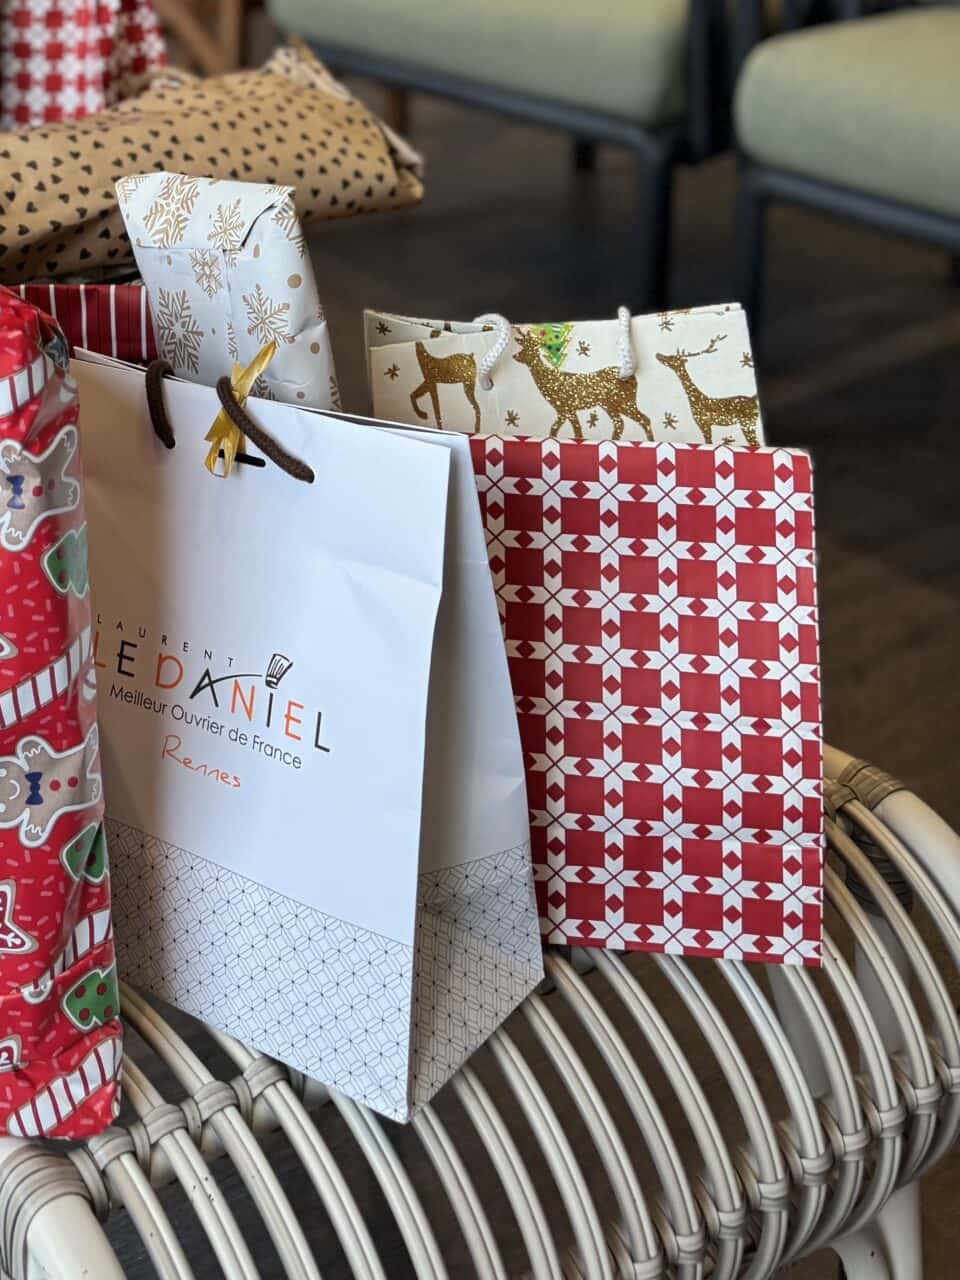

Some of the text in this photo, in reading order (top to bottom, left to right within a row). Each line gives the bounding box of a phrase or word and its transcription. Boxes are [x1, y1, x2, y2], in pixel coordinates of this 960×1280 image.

[96, 613, 234, 668] LAURENT
[109, 684, 302, 769] Meilleur Ouvrier de France
[161, 734, 241, 788] Rennes
